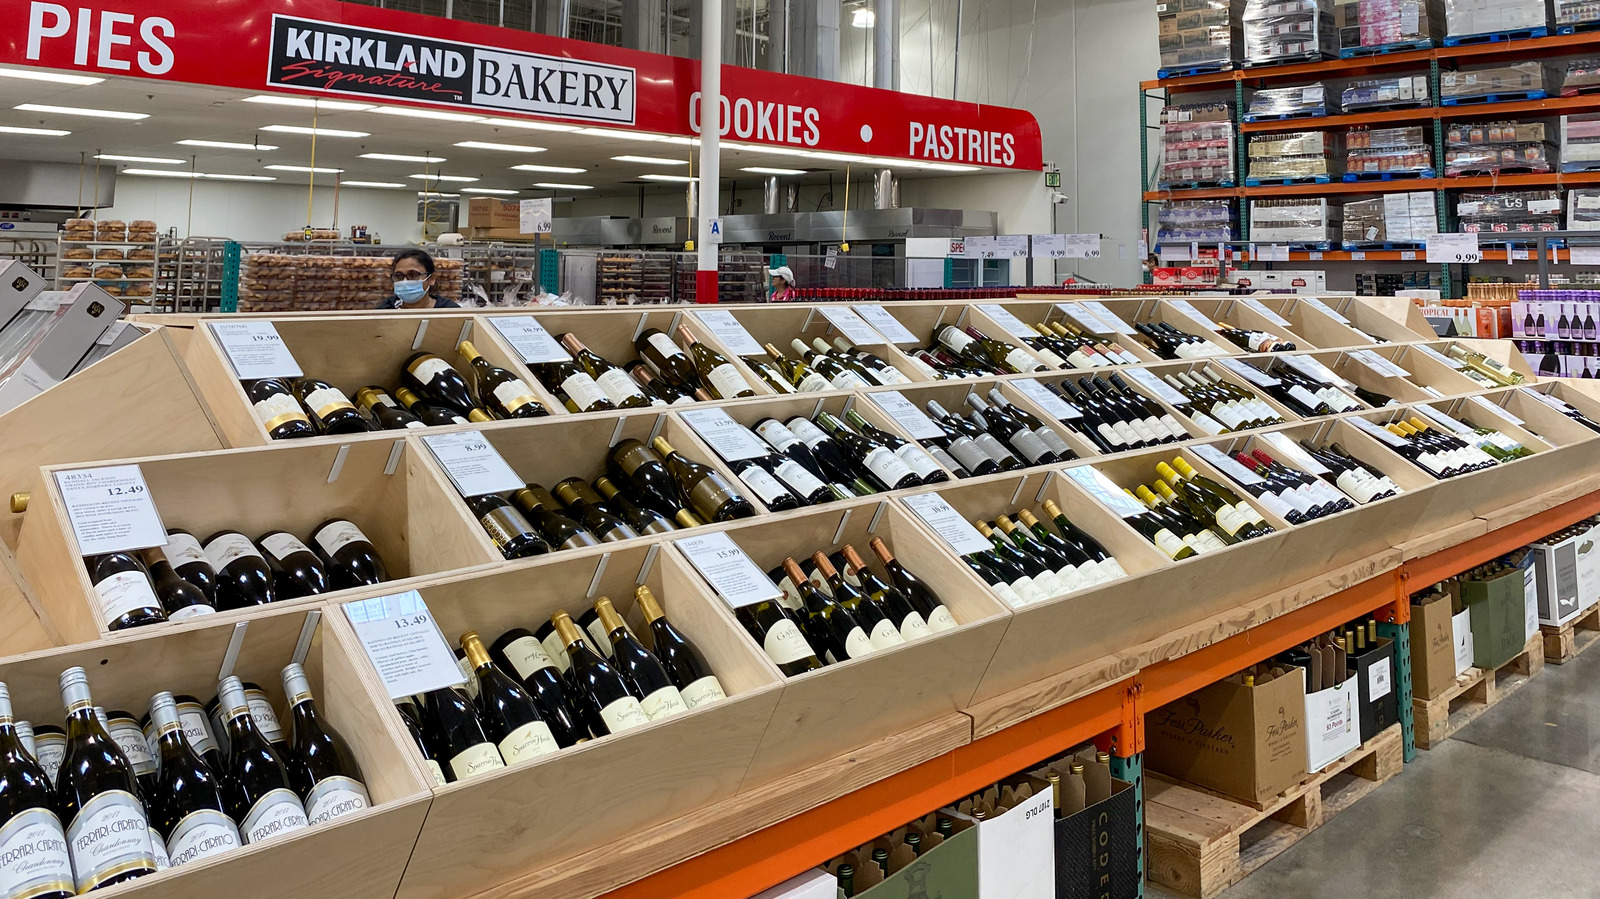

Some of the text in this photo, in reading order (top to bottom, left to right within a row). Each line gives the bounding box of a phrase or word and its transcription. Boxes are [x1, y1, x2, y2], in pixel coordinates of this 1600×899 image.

[26, 1, 175, 75] PIES
[286, 27, 467, 79] KIRKLAND
[281, 60, 463, 95] Signature
[476, 58, 629, 111] BAKERY
[909, 121, 1016, 167] PASTRIES
[538, 221, 551, 232] 6.99
[711, 221, 721, 235] A
[768, 231, 791, 241] Revent
[1012, 250, 1027, 258] 6.99
[1050, 249, 1066, 258] 9.99
[1084, 250, 1100, 258] 6.99
[1455, 253, 1478, 263] 9.99
[464, 443, 487, 452] 8.99
[64, 473, 93, 481] 48334
[107, 485, 144, 496] 12.49
[717, 548, 740, 559] 15.99
[394, 614, 427, 629] 13.49
[1184, 718, 1235, 745] Parker
[103, 810, 120, 822] 2017
[1025, 805, 1038, 820] DLG
[90, 836, 142, 857] Chardonnay
[13, 857, 65, 874] Chardonnay
